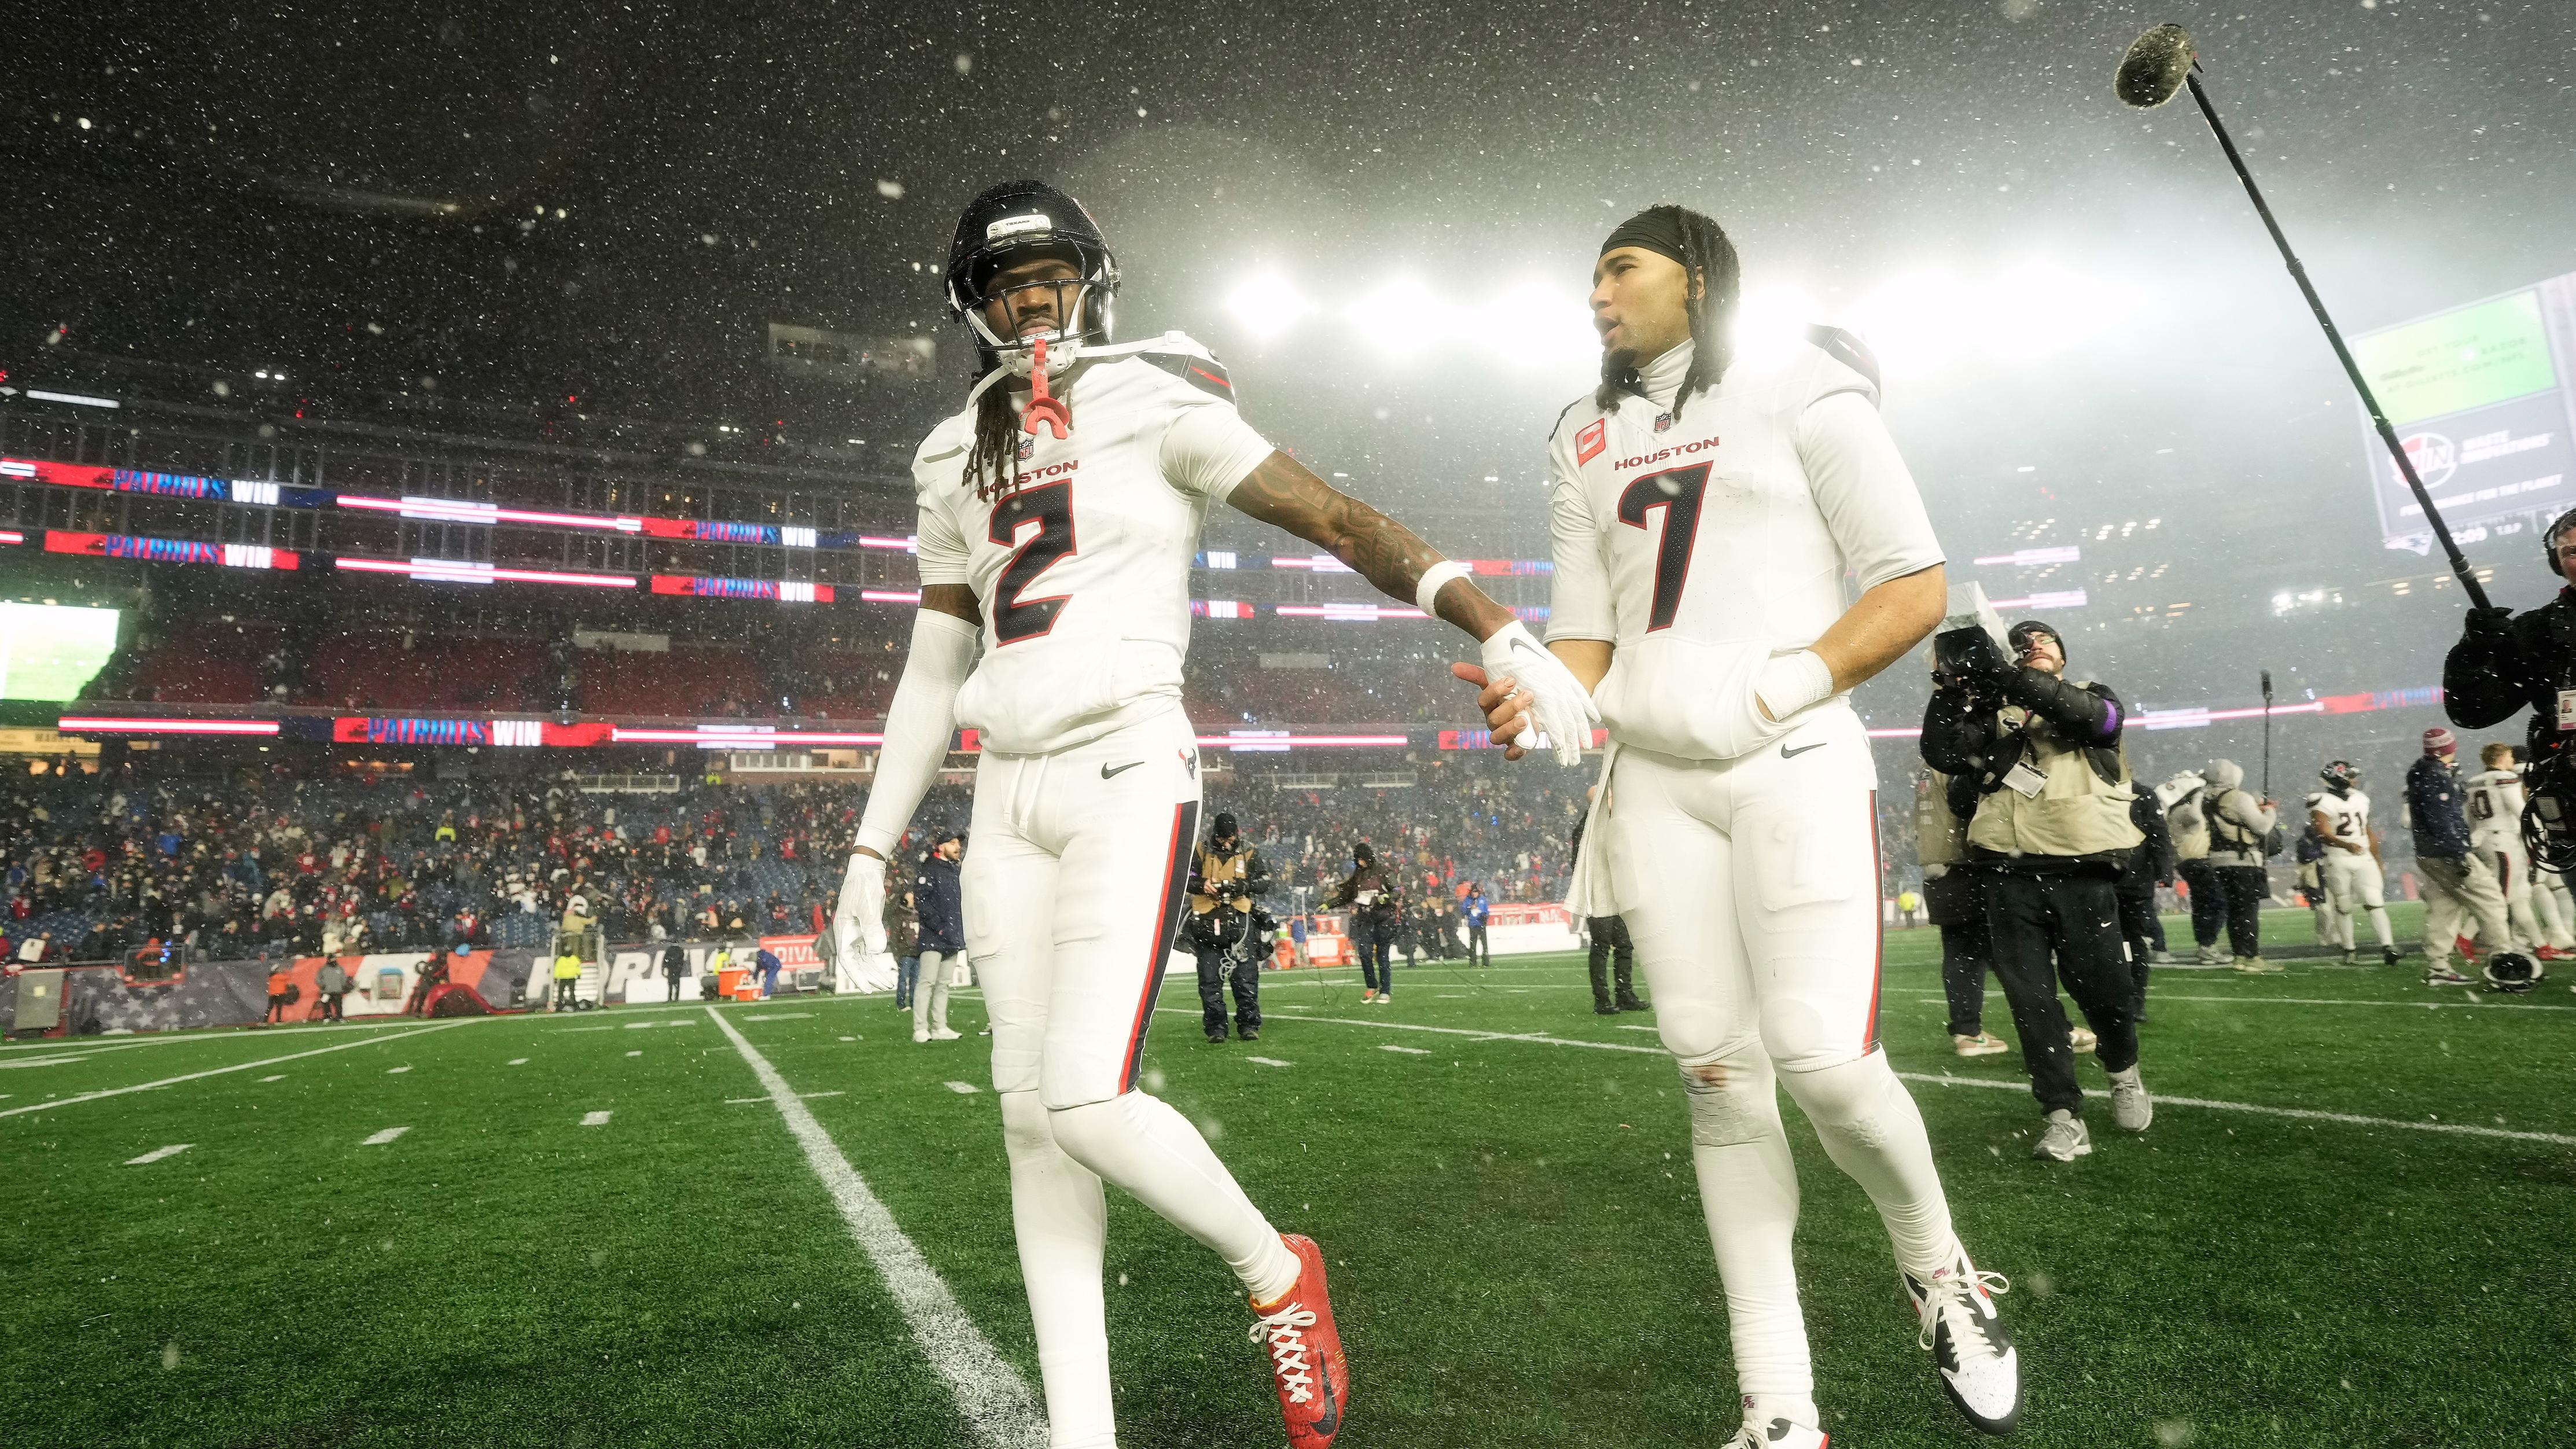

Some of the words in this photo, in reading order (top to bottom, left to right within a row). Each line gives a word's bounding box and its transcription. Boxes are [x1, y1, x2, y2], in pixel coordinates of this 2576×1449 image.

[1657, 418, 1671, 430] NFL
[1578, 422, 1602, 454] C
[1020, 446, 1033, 458] NFL
[1614, 436, 1720, 471] HOUSTON
[231, 479, 278, 505] WIN
[781, 526, 816, 548] WIN
[1618, 460, 1714, 634] 7
[225, 543, 272, 569] WIN
[988, 478, 1077, 649] 2
[1207, 551, 1237, 569] WIN
[779, 581, 815, 602] WIN
[1208, 600, 1238, 618] WIN
[492, 720, 542, 746] WIN
[2336, 811, 2365, 837] 21
